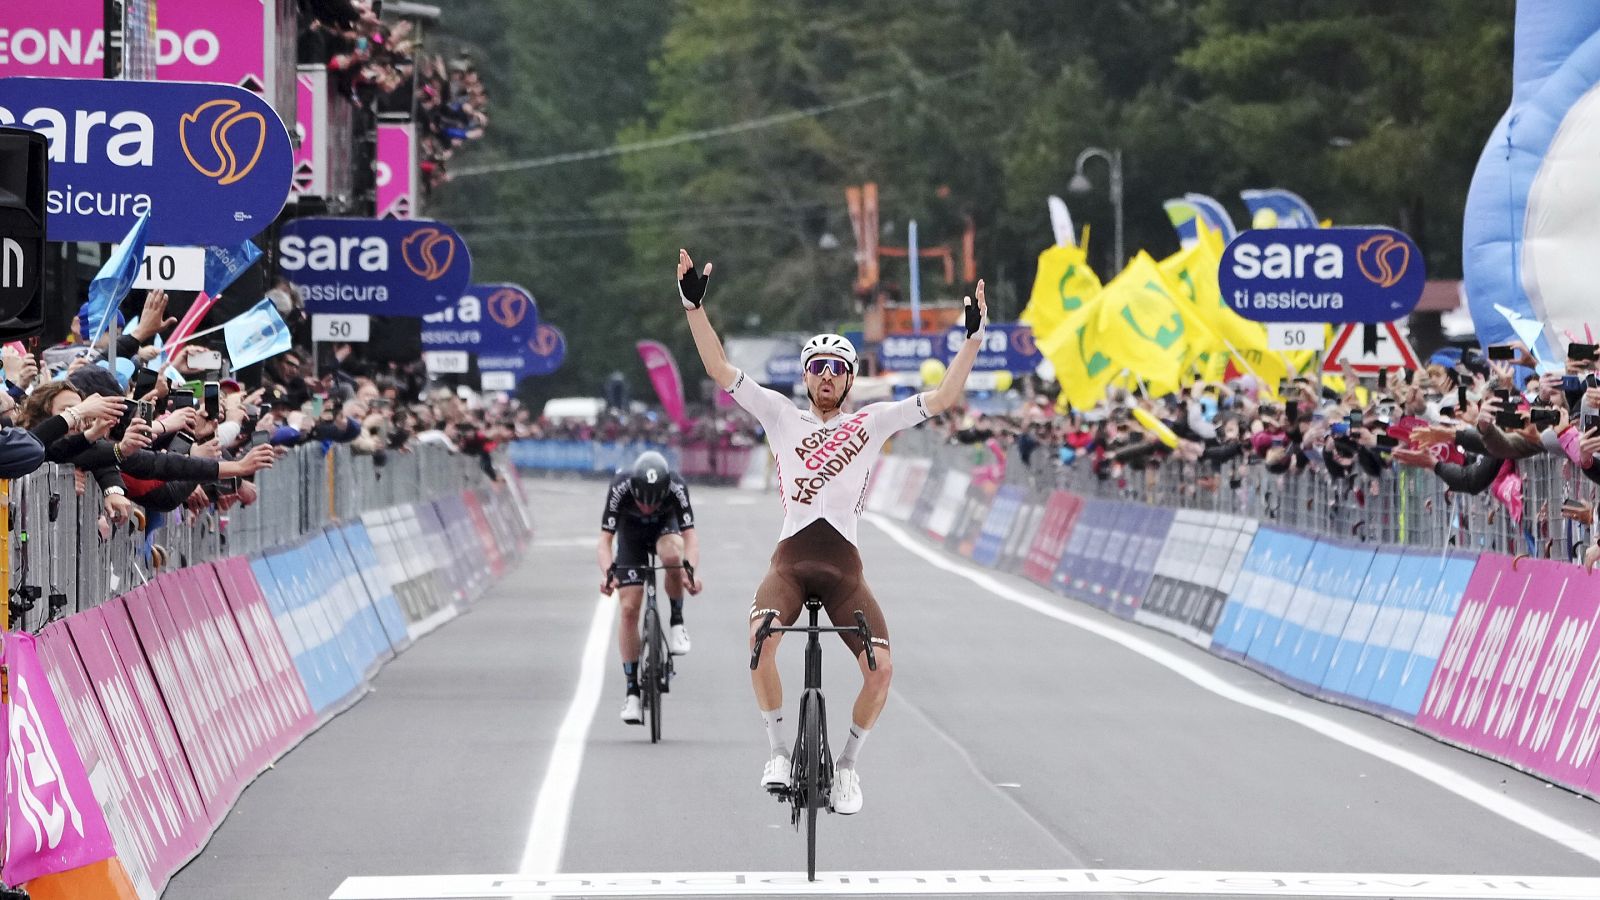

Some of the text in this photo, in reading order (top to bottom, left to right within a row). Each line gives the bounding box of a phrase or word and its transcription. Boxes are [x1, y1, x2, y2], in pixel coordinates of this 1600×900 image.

[46, 184, 152, 217] sicura
[141, 255, 176, 281] 10
[279, 235, 389, 272] sara
[1232, 242, 1343, 280] sara
[1233, 289, 1343, 310] ti assicura
[328, 323, 352, 338] 50
[1283, 331, 1306, 346] 50
[800, 427, 870, 505] MONDIALE
[791, 477, 810, 502] LA
[98, 629, 184, 846] enel
